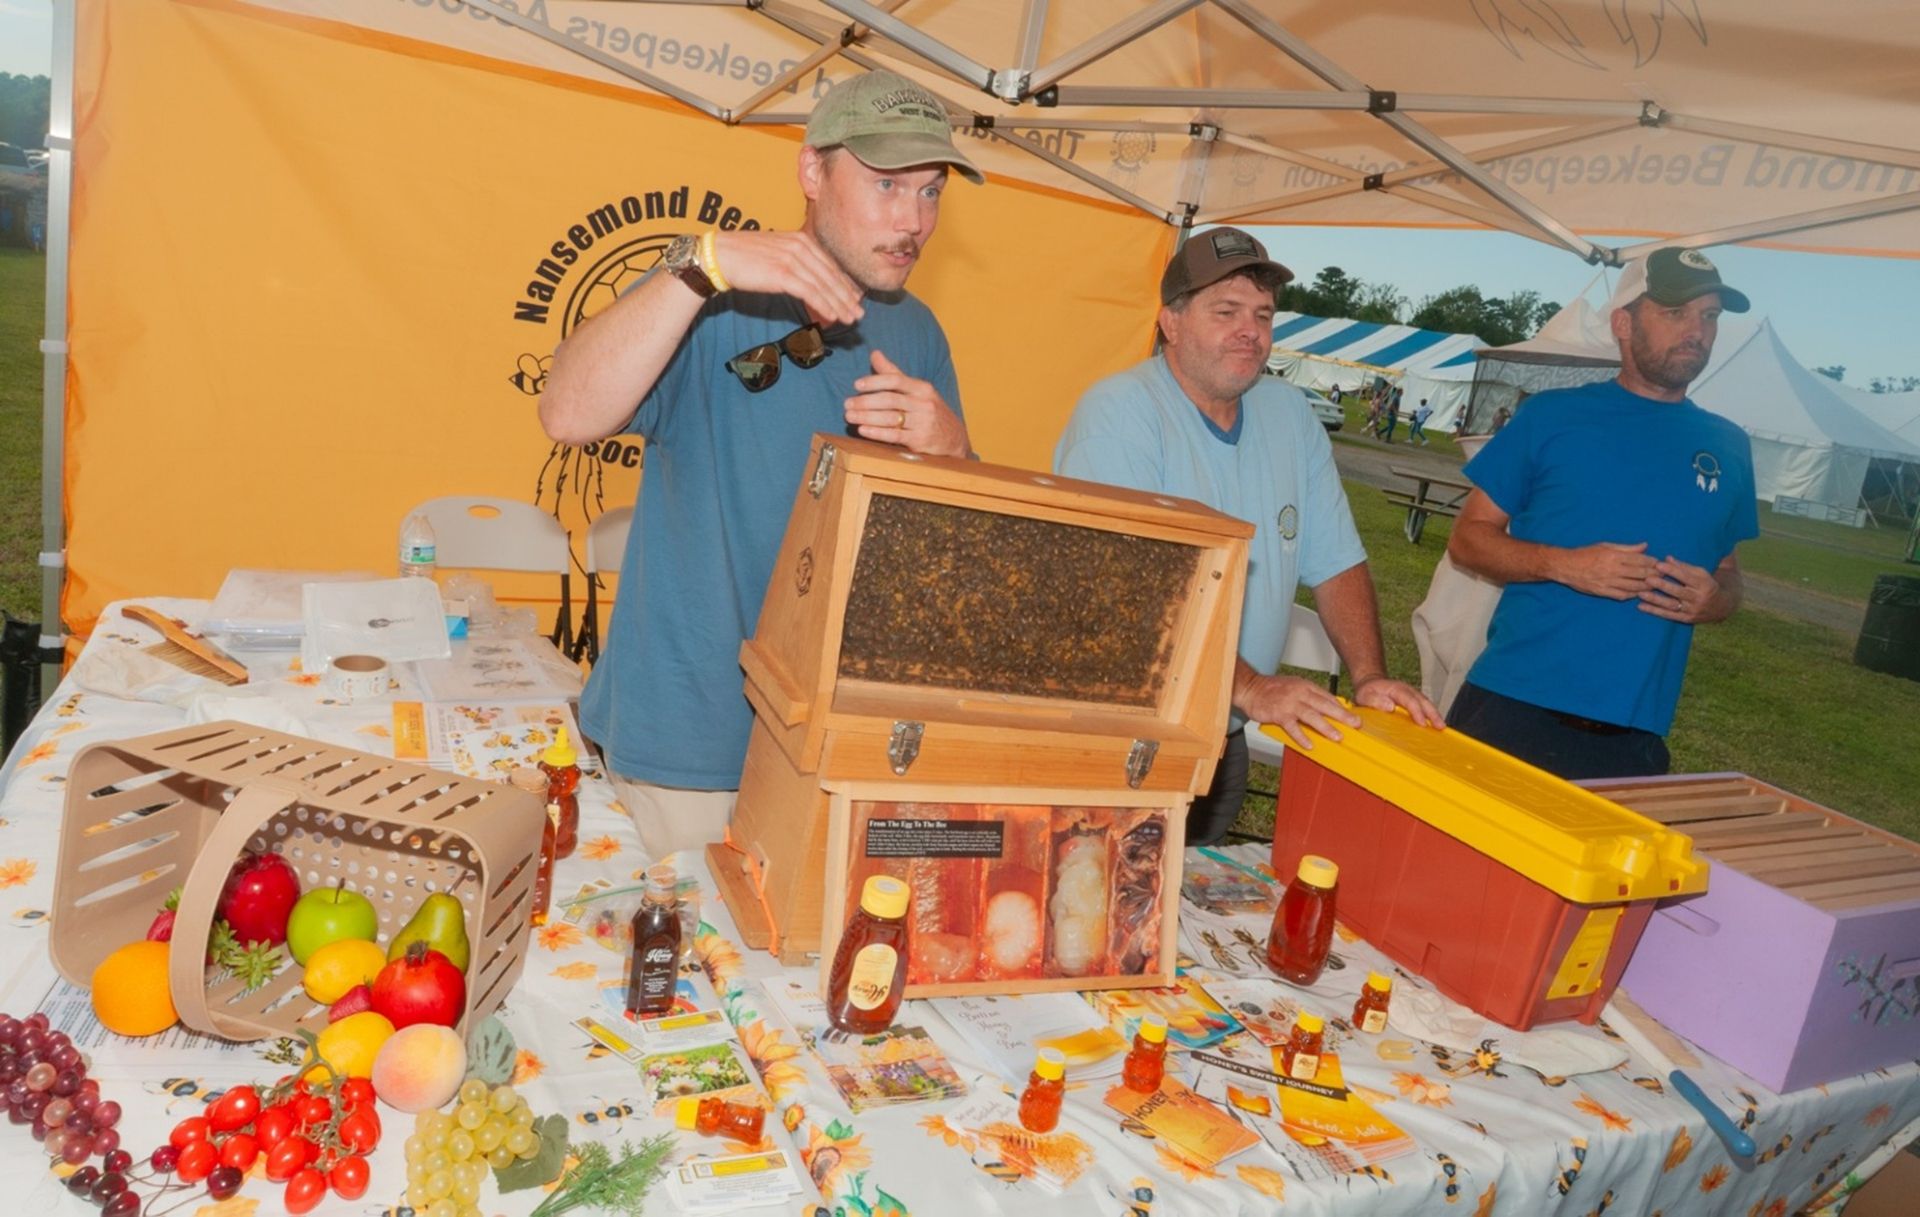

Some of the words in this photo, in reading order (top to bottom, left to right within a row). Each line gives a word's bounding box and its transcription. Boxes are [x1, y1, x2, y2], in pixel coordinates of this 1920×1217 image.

[513, 186, 690, 325] Nansemond
[869, 820, 886, 828] From
[888, 820, 900, 828] The
[901, 820, 913, 830] Egg
[923, 821, 935, 829] The
[1201, 1054, 1248, 1073] HONEY'S
[1249, 1068, 1284, 1083] SWEET
[1285, 1079, 1335, 1096] JOURNEY
[1131, 1089, 1169, 1120] HONEY
